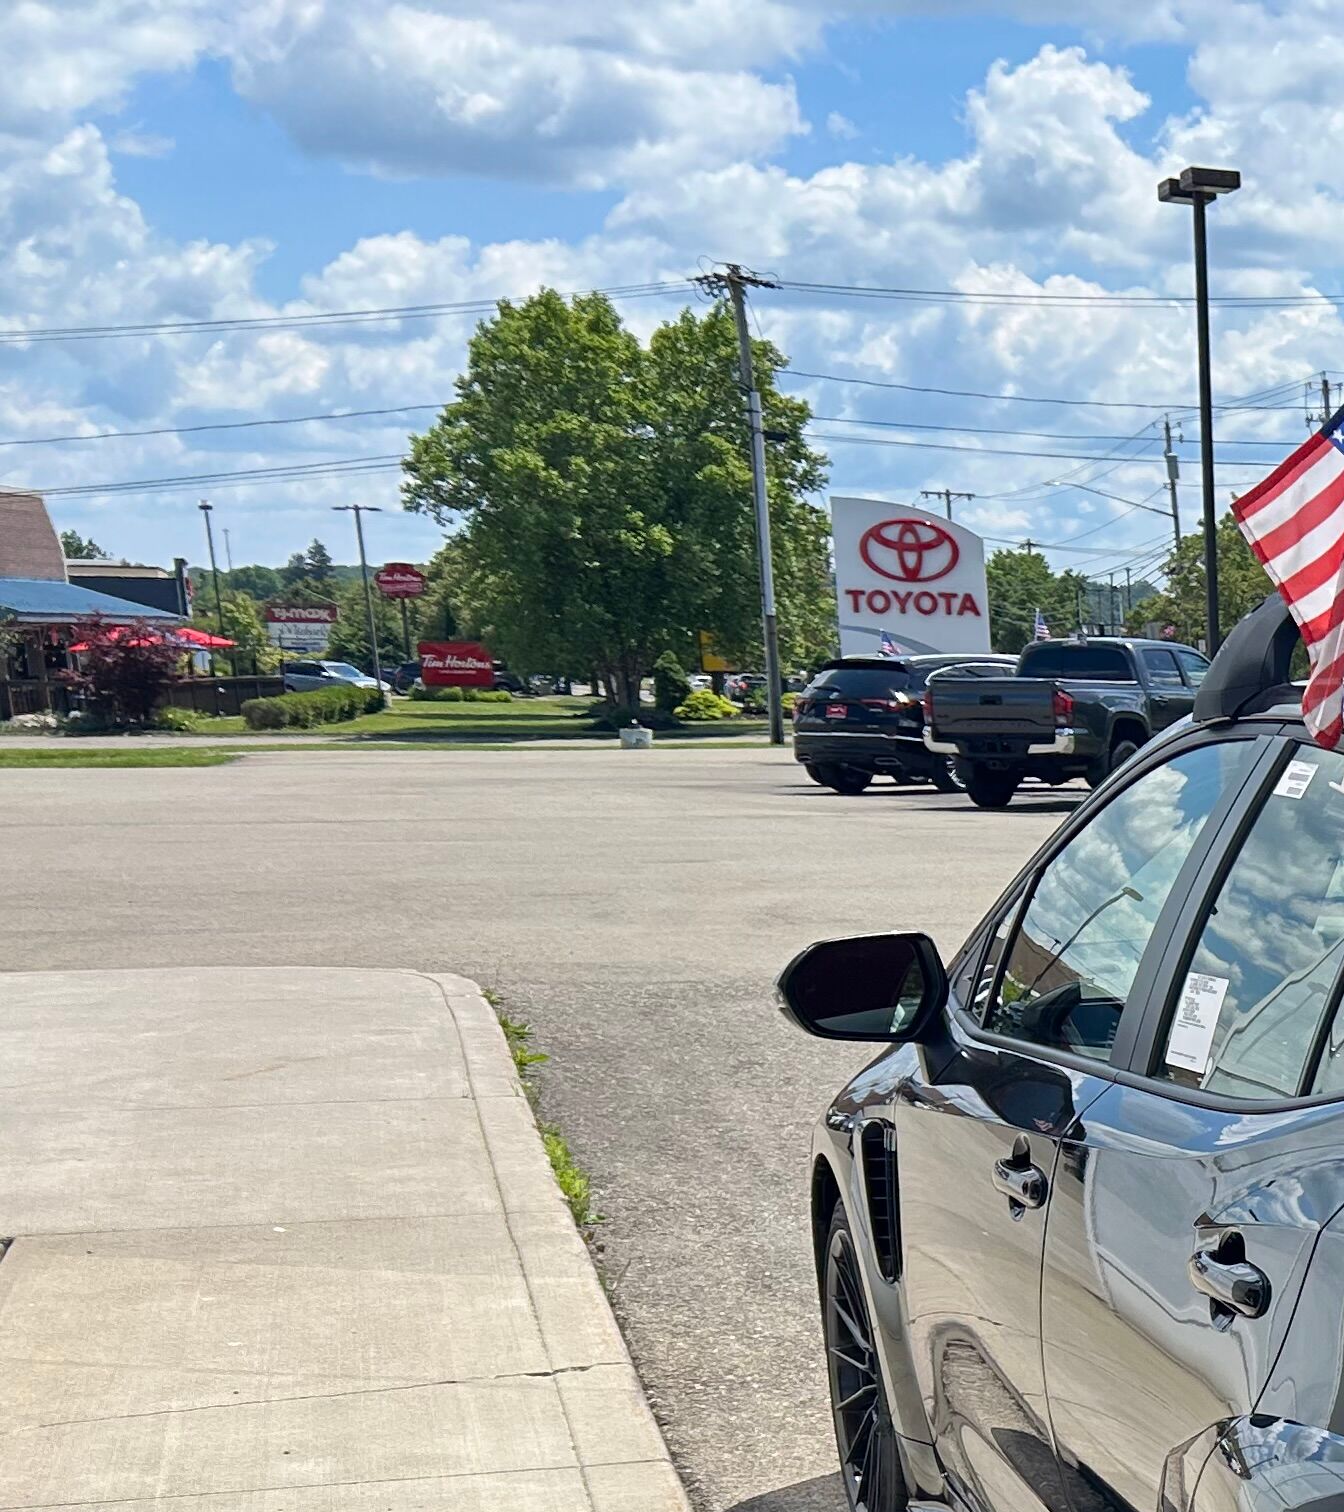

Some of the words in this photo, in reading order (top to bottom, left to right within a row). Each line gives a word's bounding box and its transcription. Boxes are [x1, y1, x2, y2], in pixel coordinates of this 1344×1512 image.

[845, 589, 981, 617] TOYOTA
[421, 654, 444, 668] Tim
[445, 655, 492, 669] Hortons
